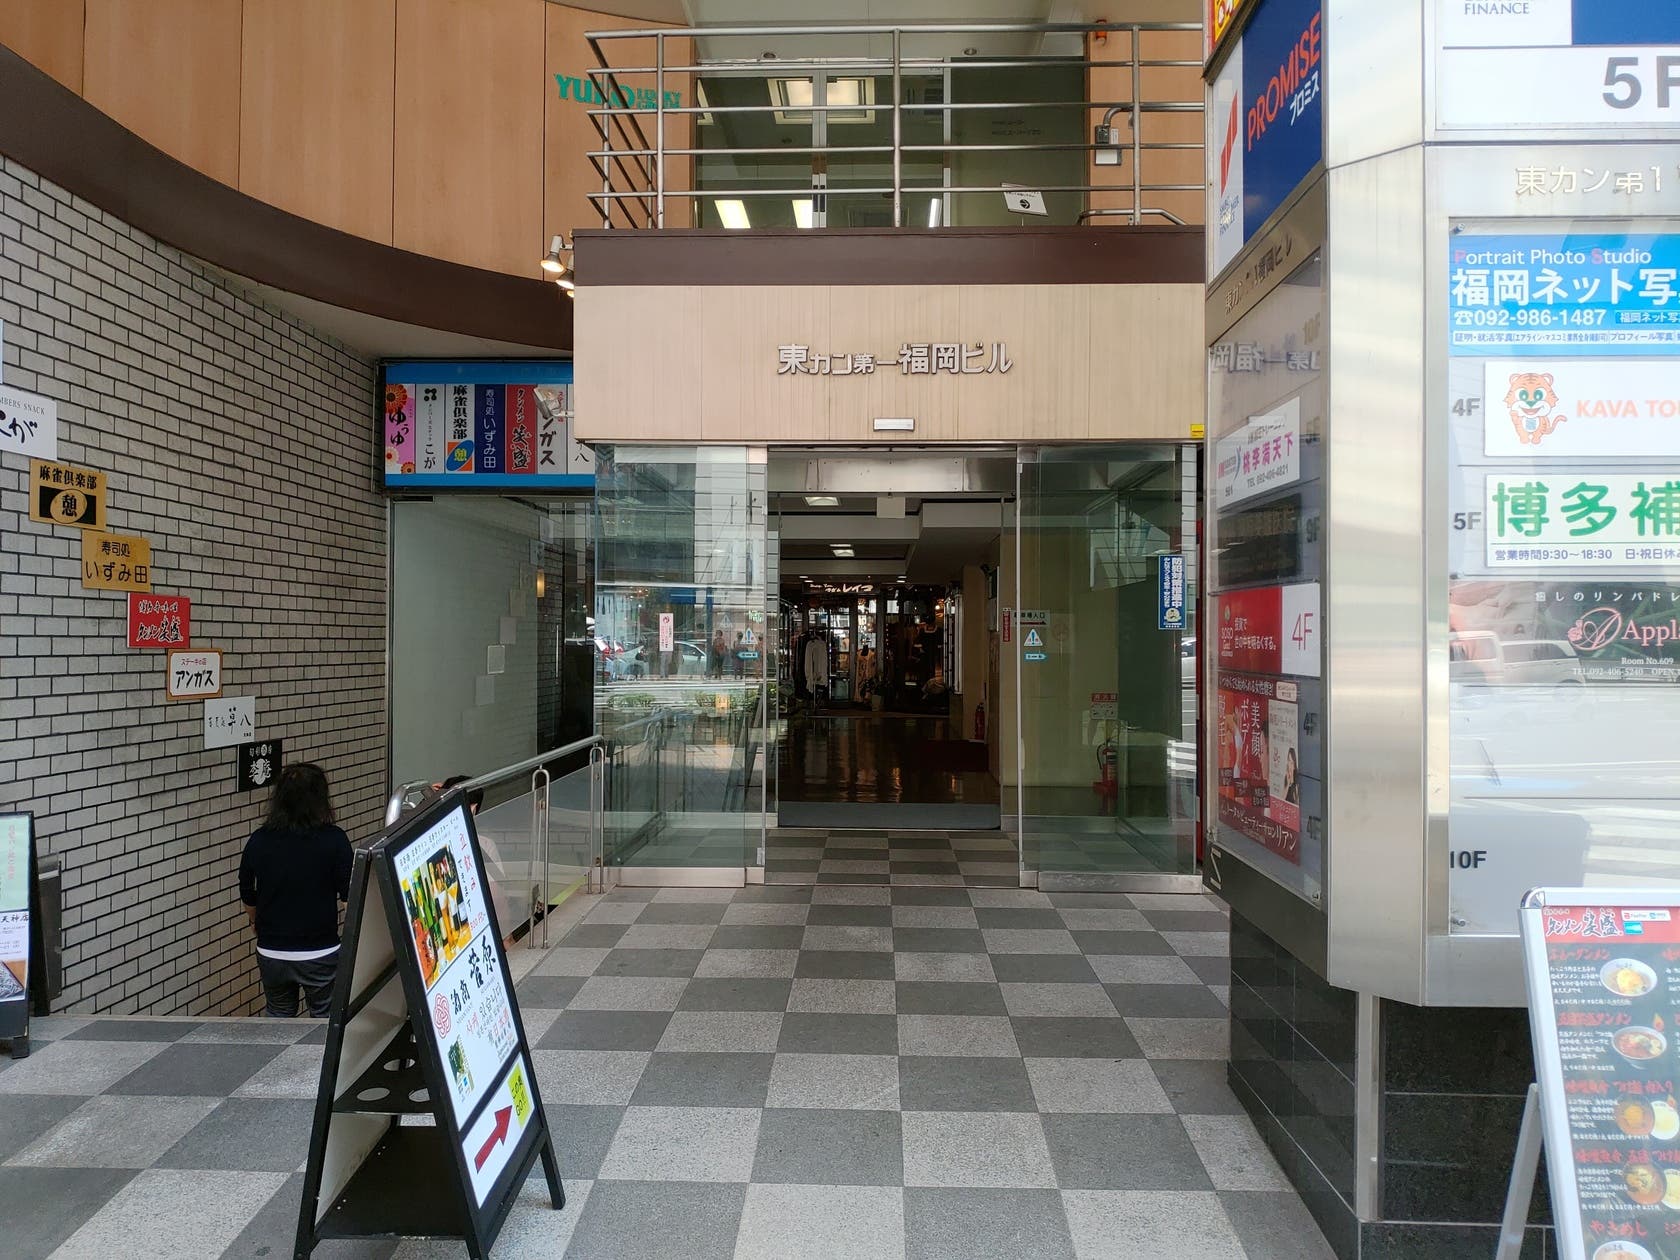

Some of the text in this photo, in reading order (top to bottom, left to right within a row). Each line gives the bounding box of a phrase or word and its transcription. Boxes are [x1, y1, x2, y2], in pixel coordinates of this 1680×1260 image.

[1464, 2, 1530, 15] FINANCE
[1247, 11, 1321, 152] PROMISE
[1602, 55, 1680, 110] 5F
[1289, 70, 1320, 126] プロミス
[1515, 165, 1680, 194] 東カン第1
[1454, 249, 1652, 265] Portrait Photo Studio
[1451, 268, 1680, 306] 福岡ネット写
[1474, 309, 1607, 326] 092-986-1487
[1620, 312, 1680, 323] 福岡ネット写
[777, 343, 1013, 375] 東カン第一福岡ビル
[24, 403, 45, 415] SNACK
[453, 385, 468, 440] 麻雀倶楽部
[1452, 398, 1481, 416] 4F
[1576, 400, 1680, 417] KAVA TO
[540, 416, 556, 466] ンガス
[424, 443, 436, 469] こが
[39, 465, 97, 489] 麻雀倶楽部
[61, 494, 78, 517] 憩
[1492, 482, 1680, 537] 博多補
[1453, 512, 1482, 530] 5F
[101, 541, 131, 557] 寿司処
[85, 562, 148, 584] いずみ田
[1292, 612, 1313, 651] 4F
[1622, 619, 1680, 646] Appl
[1646, 657, 1674, 665] No.609
[176, 670, 214, 689] アンガス
[1450, 851, 1487, 869] 10F
